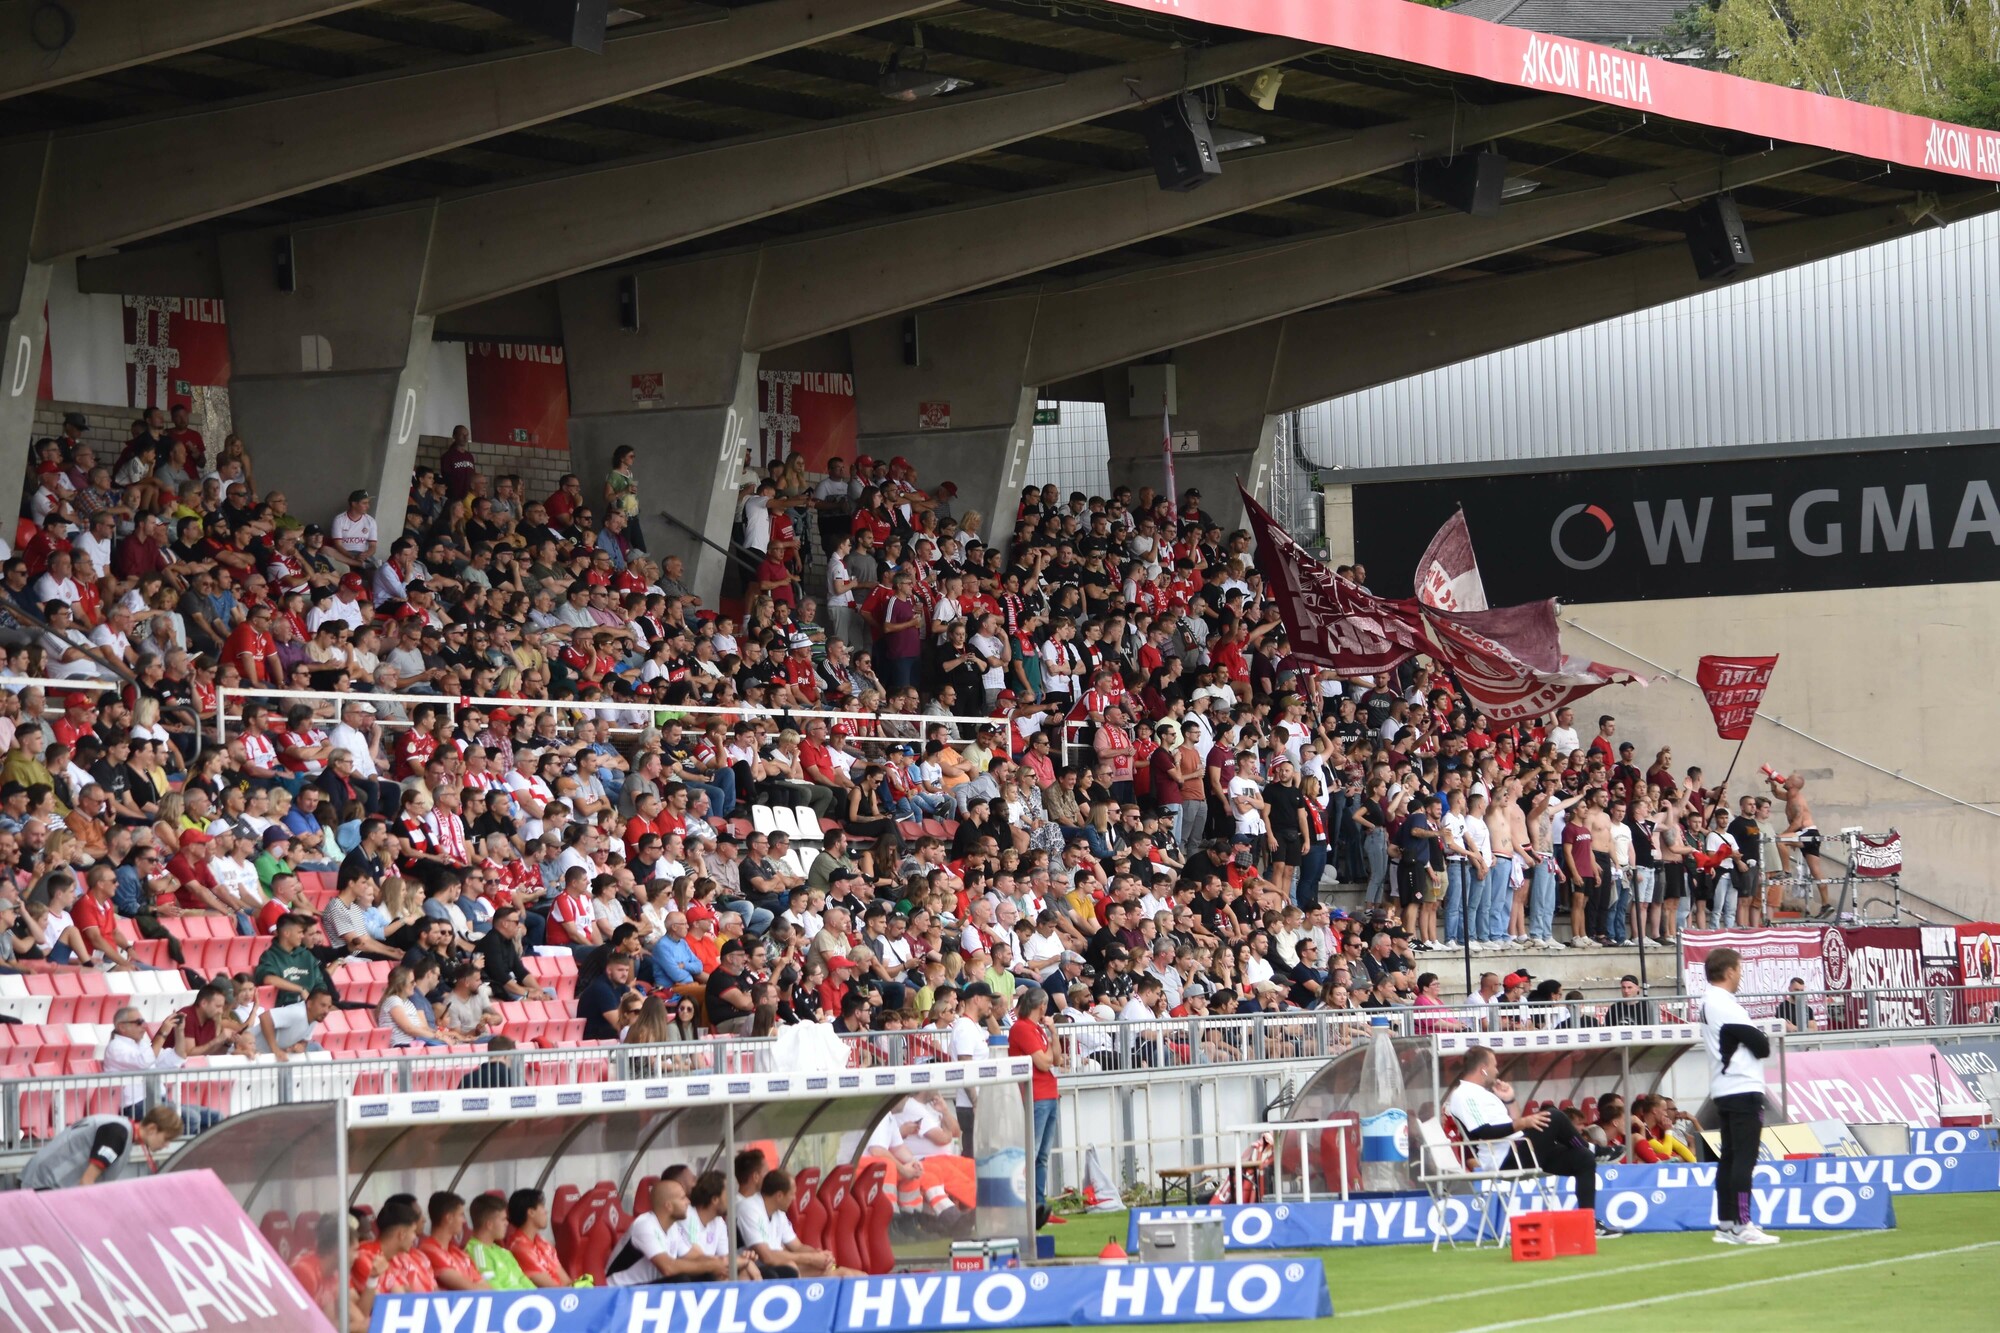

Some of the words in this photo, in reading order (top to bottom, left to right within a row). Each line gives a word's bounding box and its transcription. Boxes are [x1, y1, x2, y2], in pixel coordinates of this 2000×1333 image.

[1587, 50, 1653, 105] ARENA
[398, 388, 416, 445] D
[1008, 439, 1025, 488] E
[1633, 480, 2000, 566] WEGMA
[1944, 1051, 1998, 1076] MARCO
[956, 1259, 981, 1271] tape
